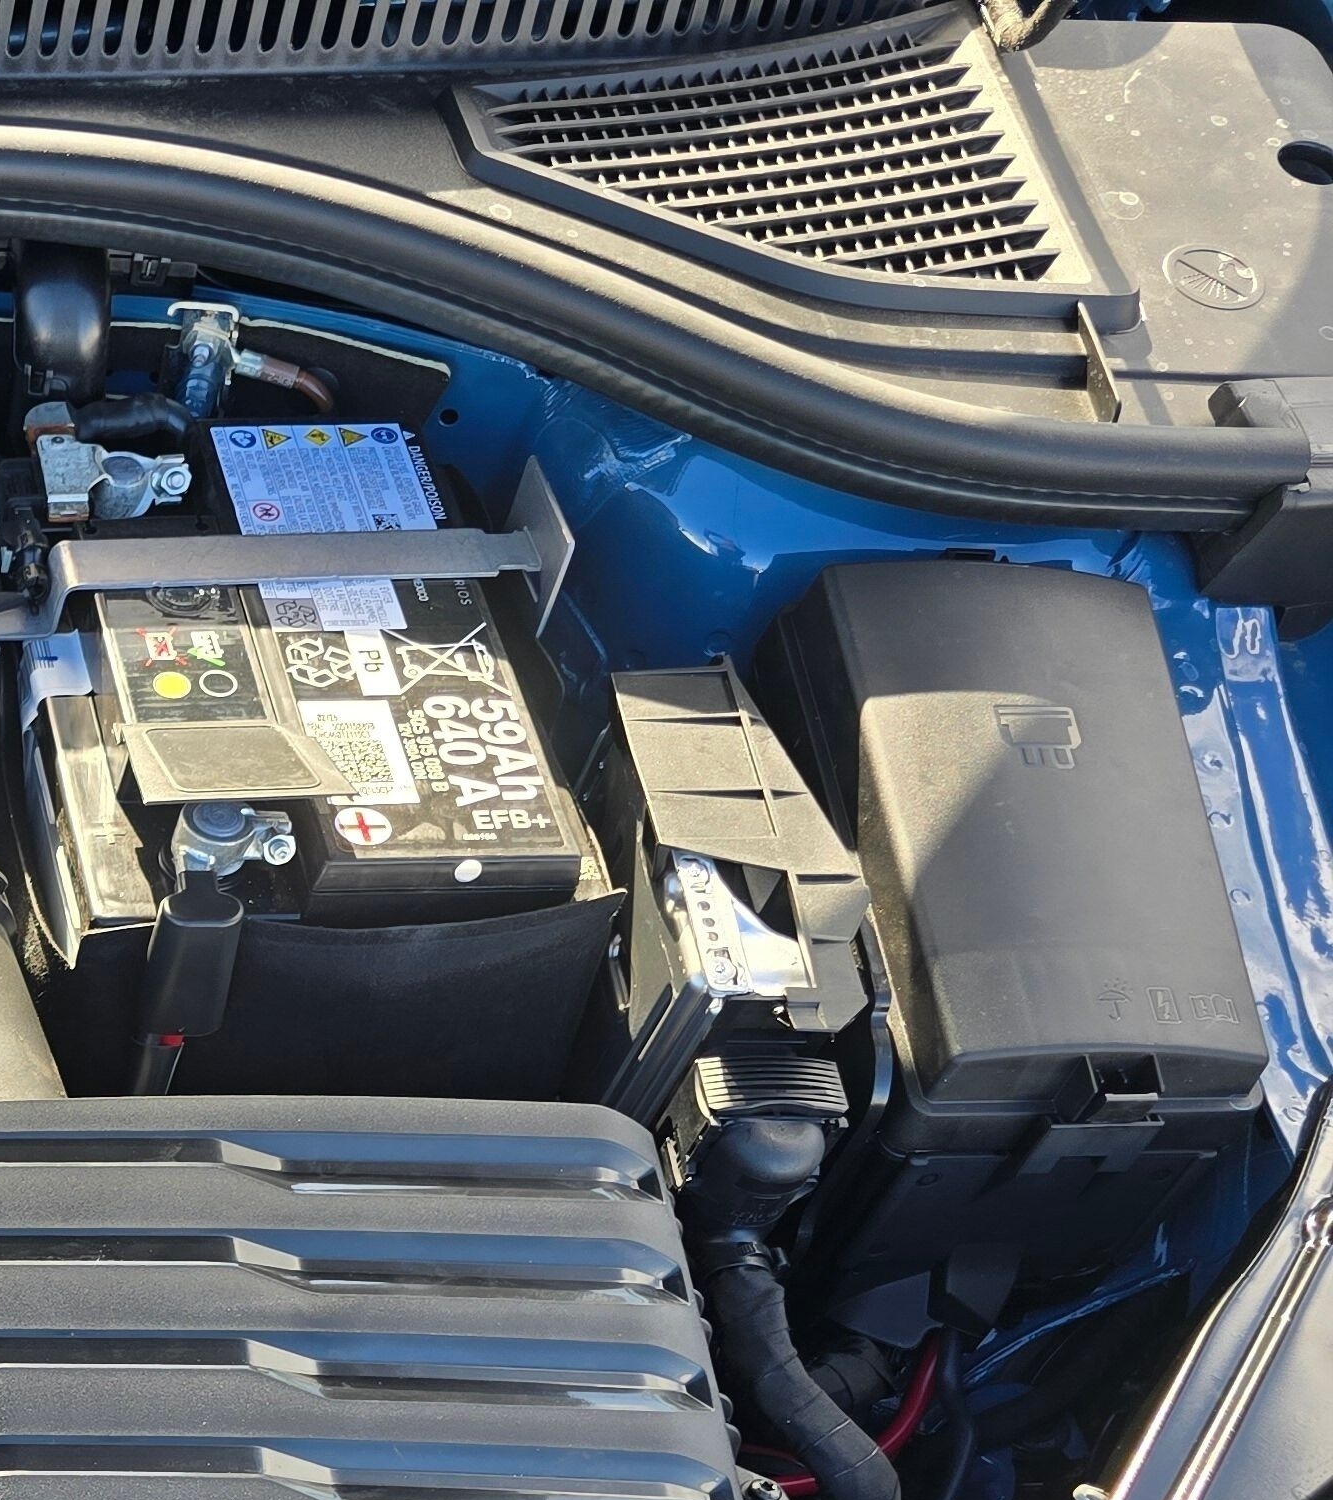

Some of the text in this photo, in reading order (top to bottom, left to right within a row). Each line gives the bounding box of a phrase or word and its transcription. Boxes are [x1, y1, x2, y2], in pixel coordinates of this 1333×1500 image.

[408, 445, 447, 520] DANGER/POISON
[358, 649, 380, 673] Pb
[422, 695, 487, 766] 640
[470, 698, 546, 801] 59Ah
[448, 776, 500, 806] A
[473, 810, 550, 830] EFB+
